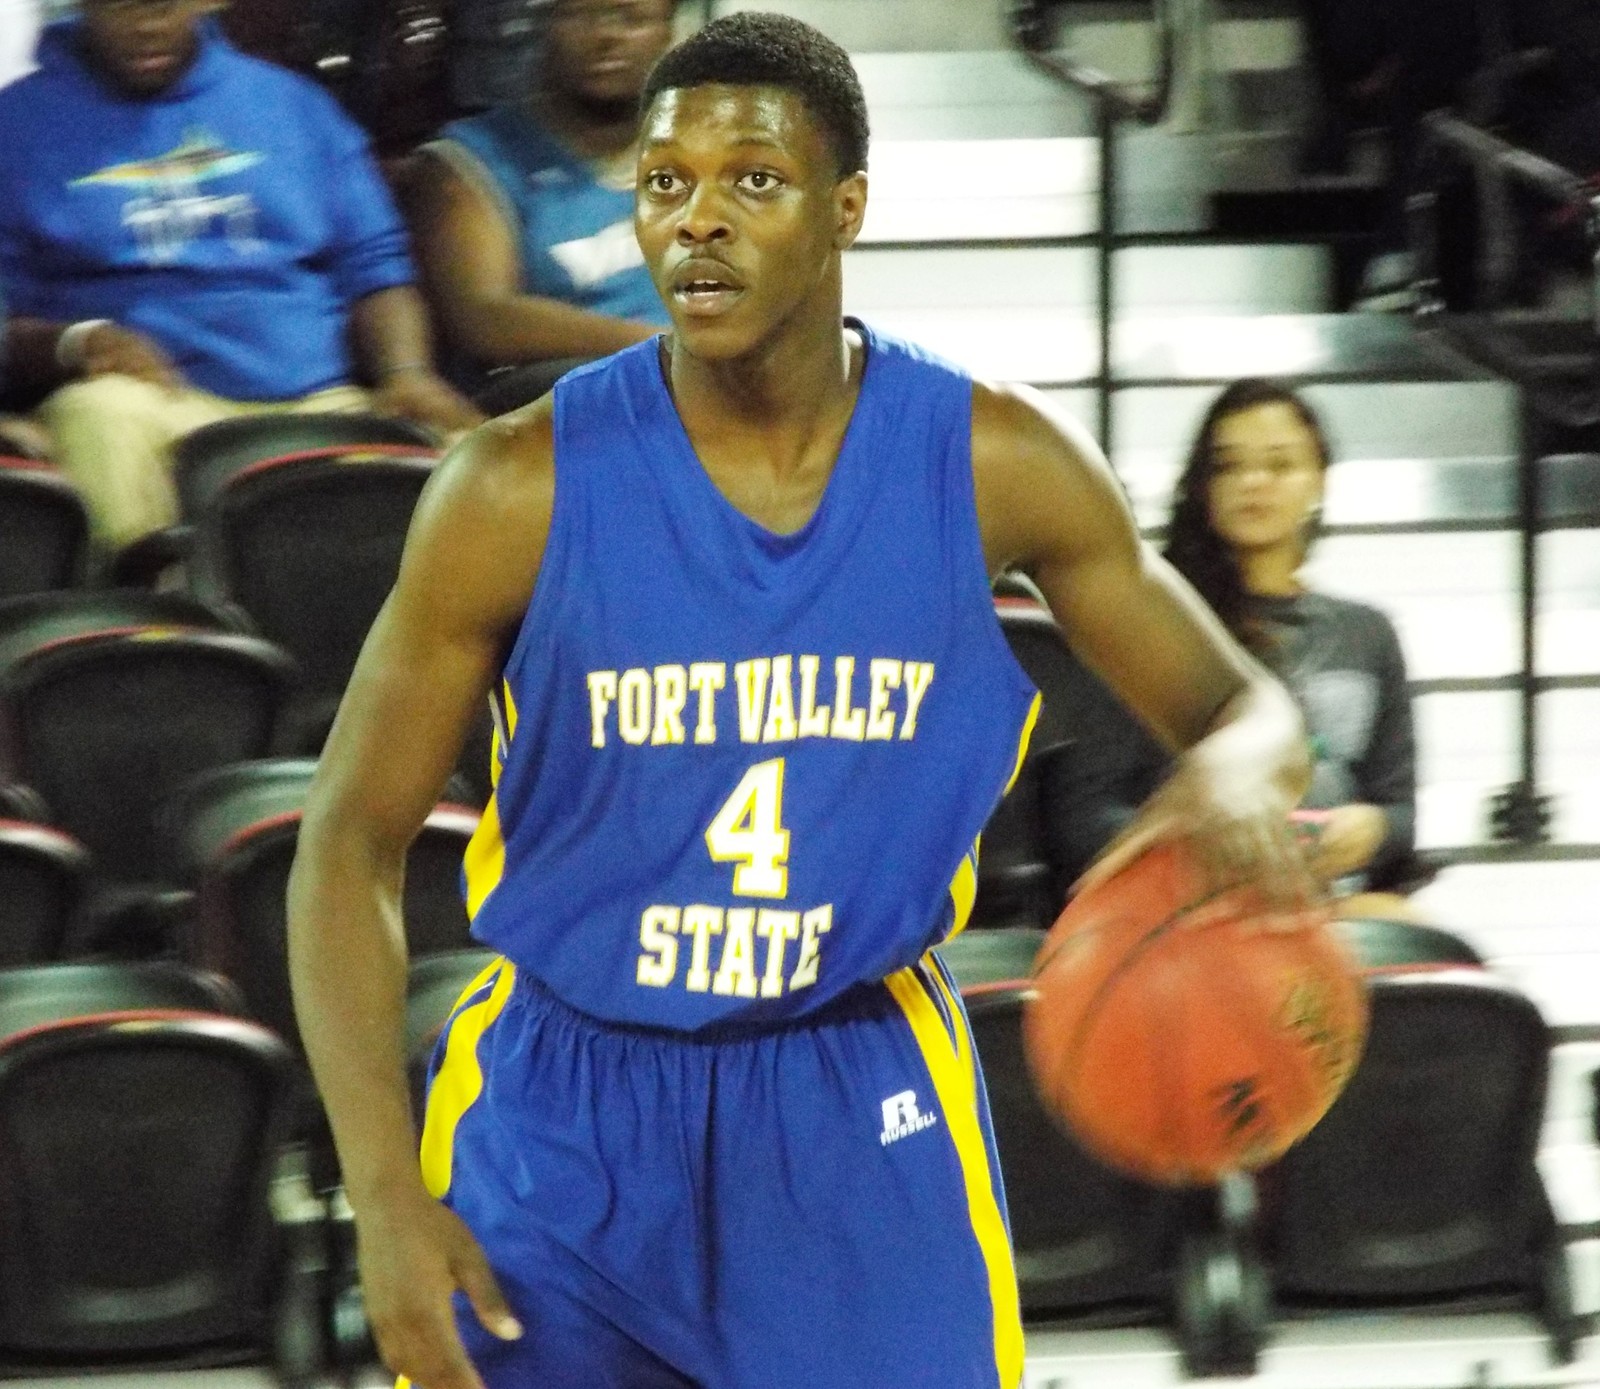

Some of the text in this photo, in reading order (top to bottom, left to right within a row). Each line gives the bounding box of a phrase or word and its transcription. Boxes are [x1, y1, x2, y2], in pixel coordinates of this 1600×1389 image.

[586, 654, 935, 748] FORT VALLEY
[704, 756, 791, 899] 4
[636, 903, 833, 999] STATE
